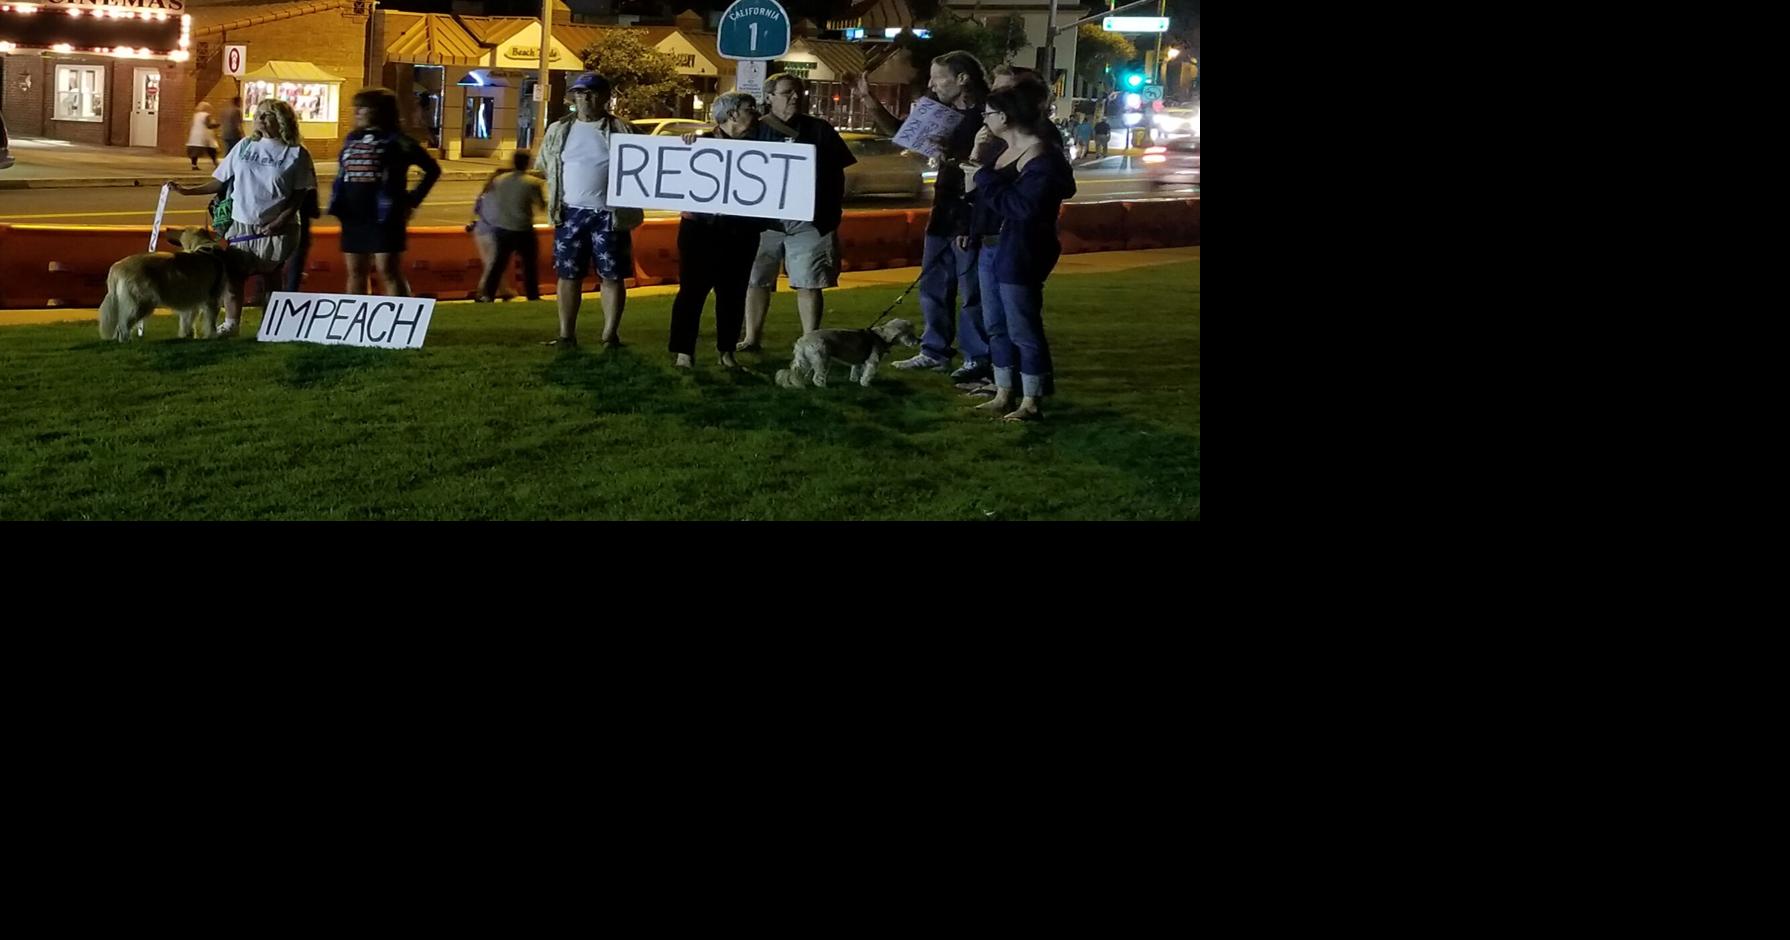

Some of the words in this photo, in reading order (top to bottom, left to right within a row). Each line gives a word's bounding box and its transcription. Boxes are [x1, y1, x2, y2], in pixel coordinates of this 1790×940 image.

[49, 0, 184, 10] EMAS
[729, 7, 780, 21] CALIFORNIA
[748, 22, 758, 51] 1
[512, 47, 535, 57] Beach
[616, 143, 807, 210] RESIST
[265, 299, 424, 345] IMPEACH
